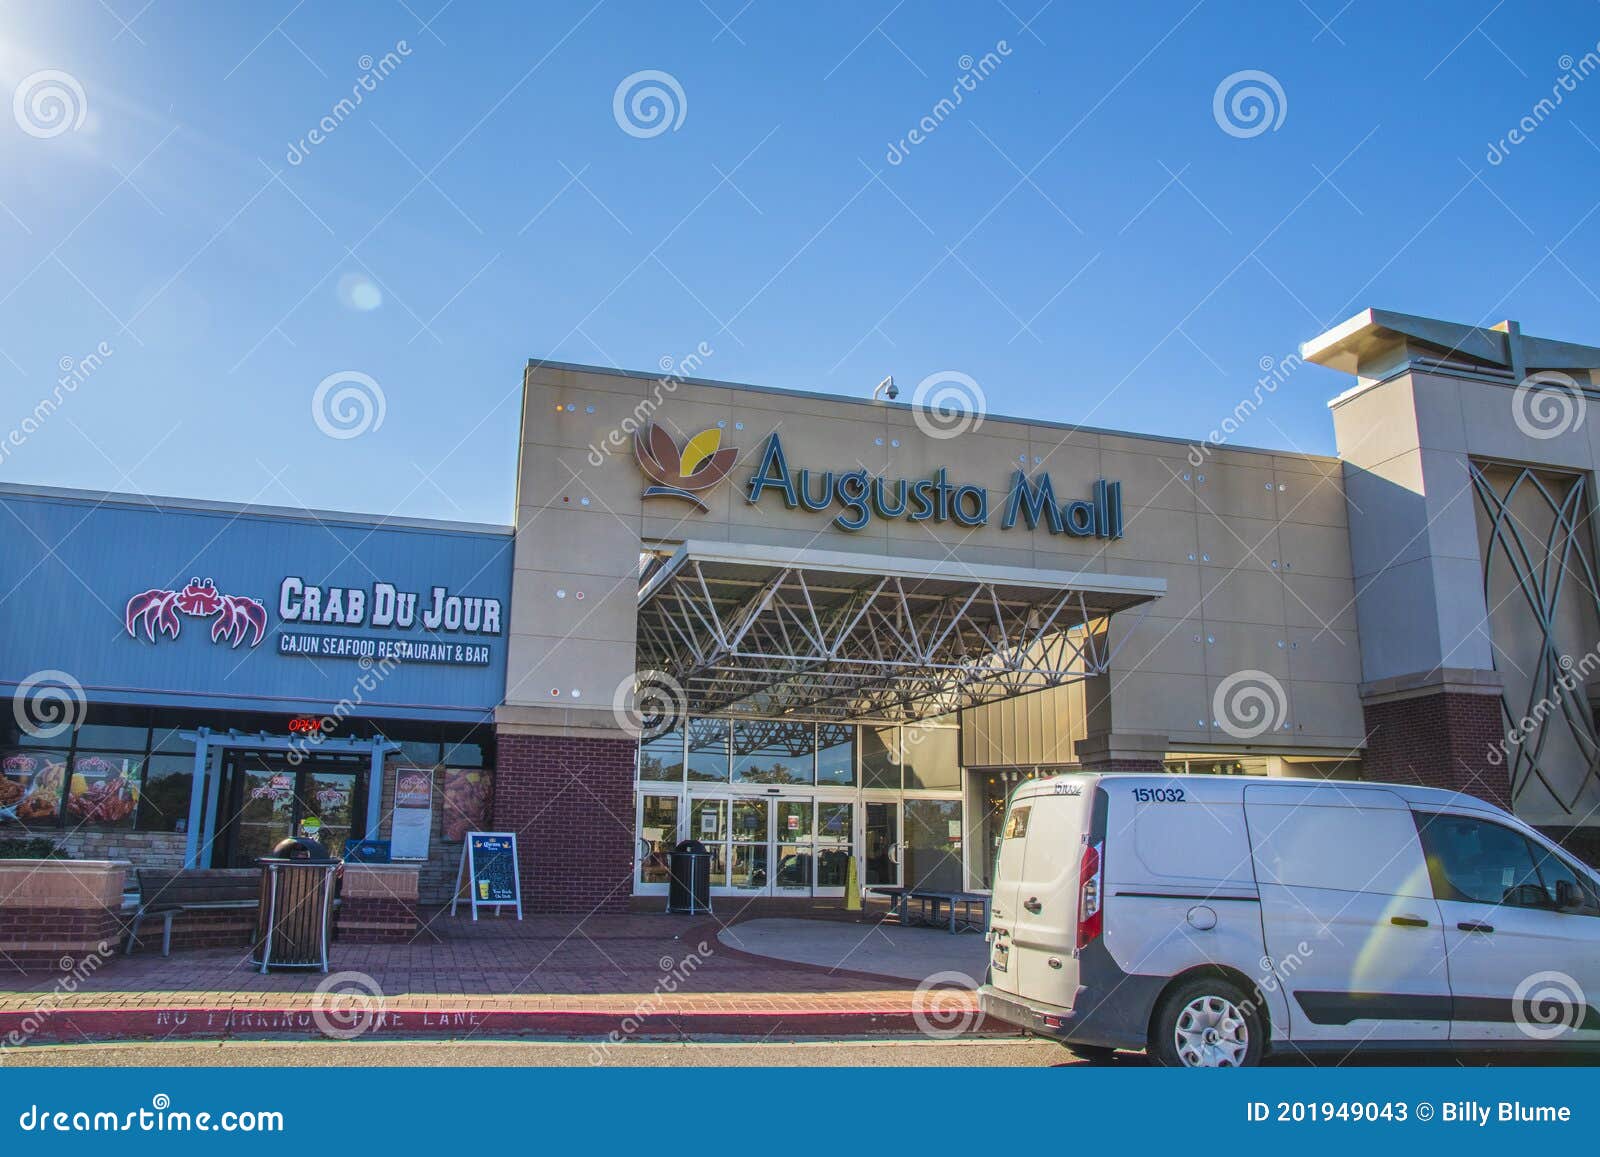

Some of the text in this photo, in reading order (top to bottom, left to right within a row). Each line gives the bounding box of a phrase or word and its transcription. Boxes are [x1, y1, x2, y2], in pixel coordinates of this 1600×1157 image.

[747, 431, 1123, 540] Augusta Mall
[279, 576, 501, 634] CRAB DU JOUR
[281, 634, 489, 662] CAJUN SEAFOOD RESTAURANT & BAR
[288, 719, 320, 731] OPEN
[1132, 788, 1186, 802] 151032
[423, 1012, 480, 1026] LANE
